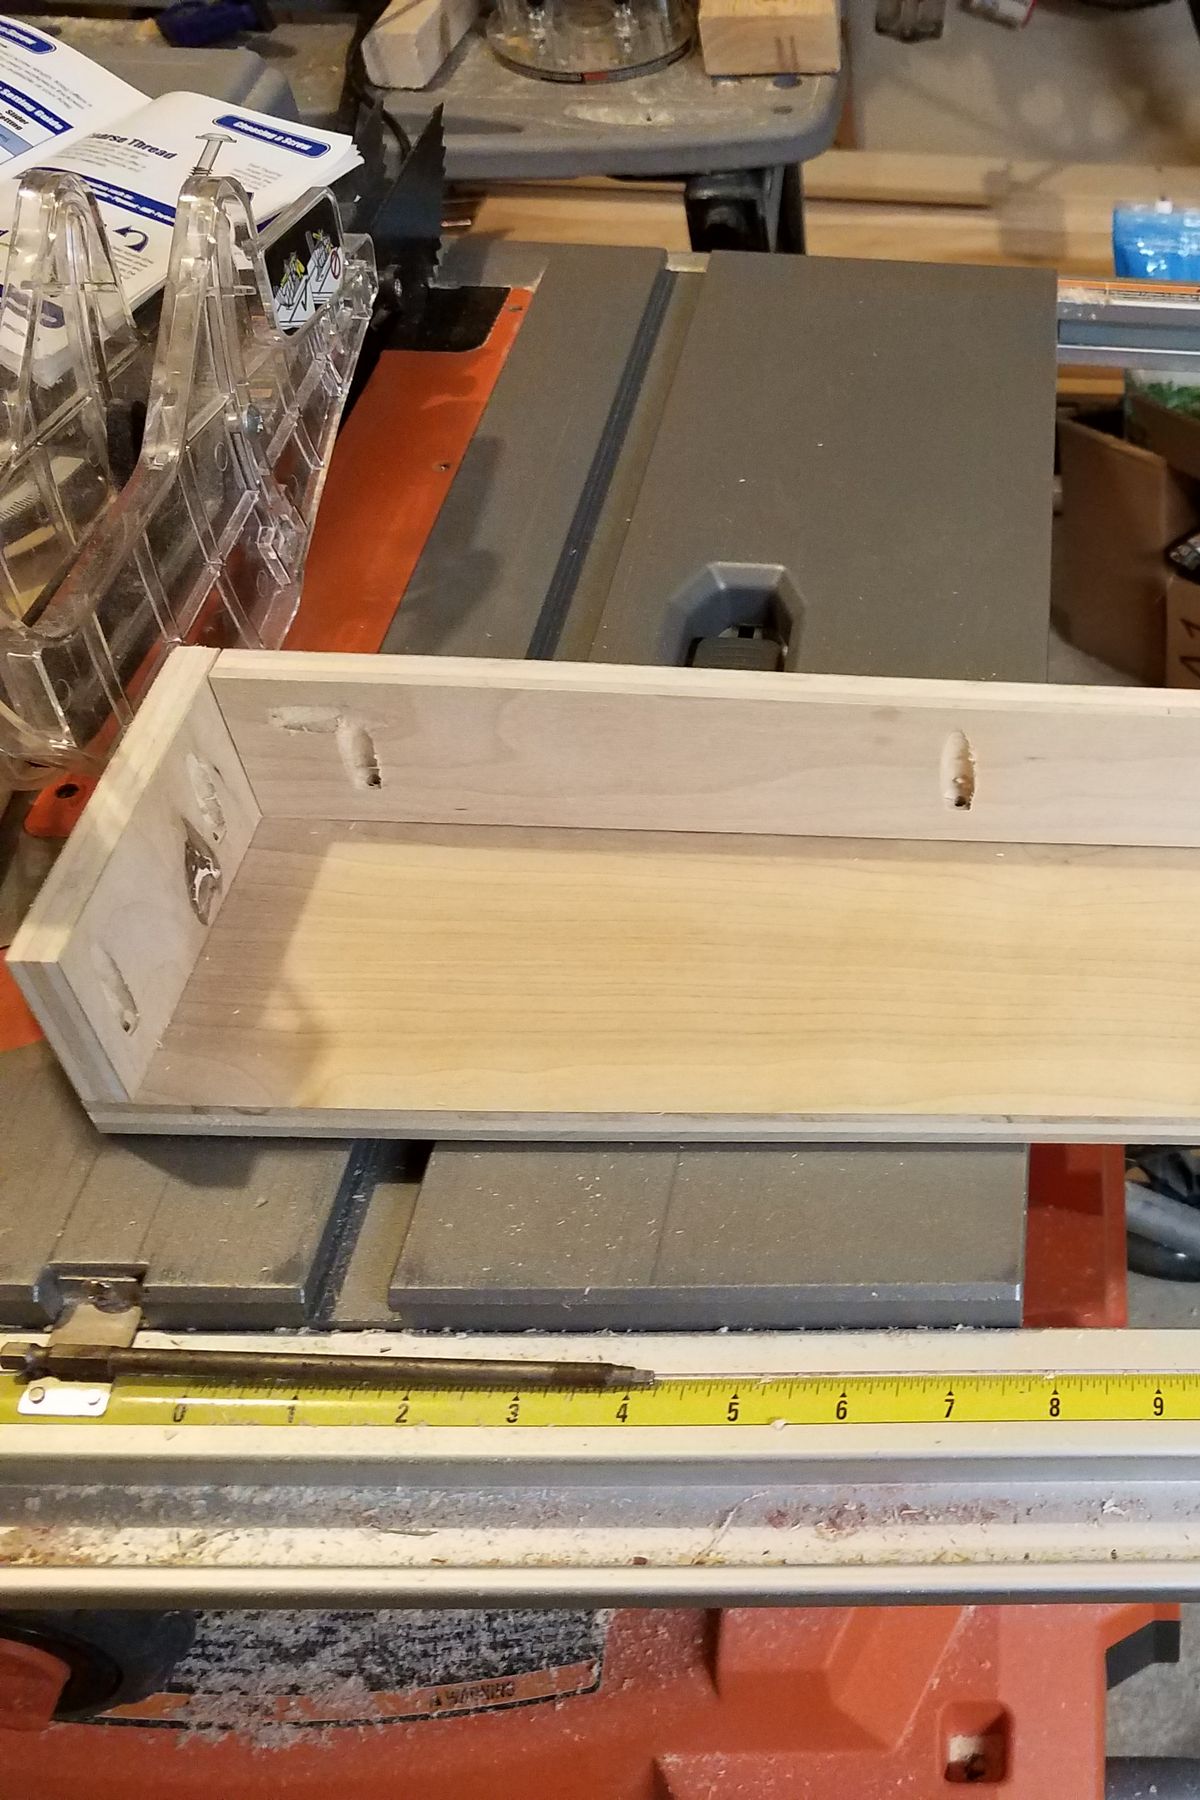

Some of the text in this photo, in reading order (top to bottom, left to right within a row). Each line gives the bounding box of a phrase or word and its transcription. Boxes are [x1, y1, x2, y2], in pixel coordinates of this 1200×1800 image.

[128, 138, 178, 160] Thread
[172, 1404, 186, 1423] 0
[394, 1403, 409, 1423] 2
[506, 1403, 520, 1423] 3
[616, 1402, 628, 1422] 4
[727, 1401, 739, 1421] 5
[835, 1400, 847, 1420] 6
[944, 1399, 955, 1418] 7
[1049, 1397, 1060, 1417] 8
[1153, 1397, 1164, 1416] 9
